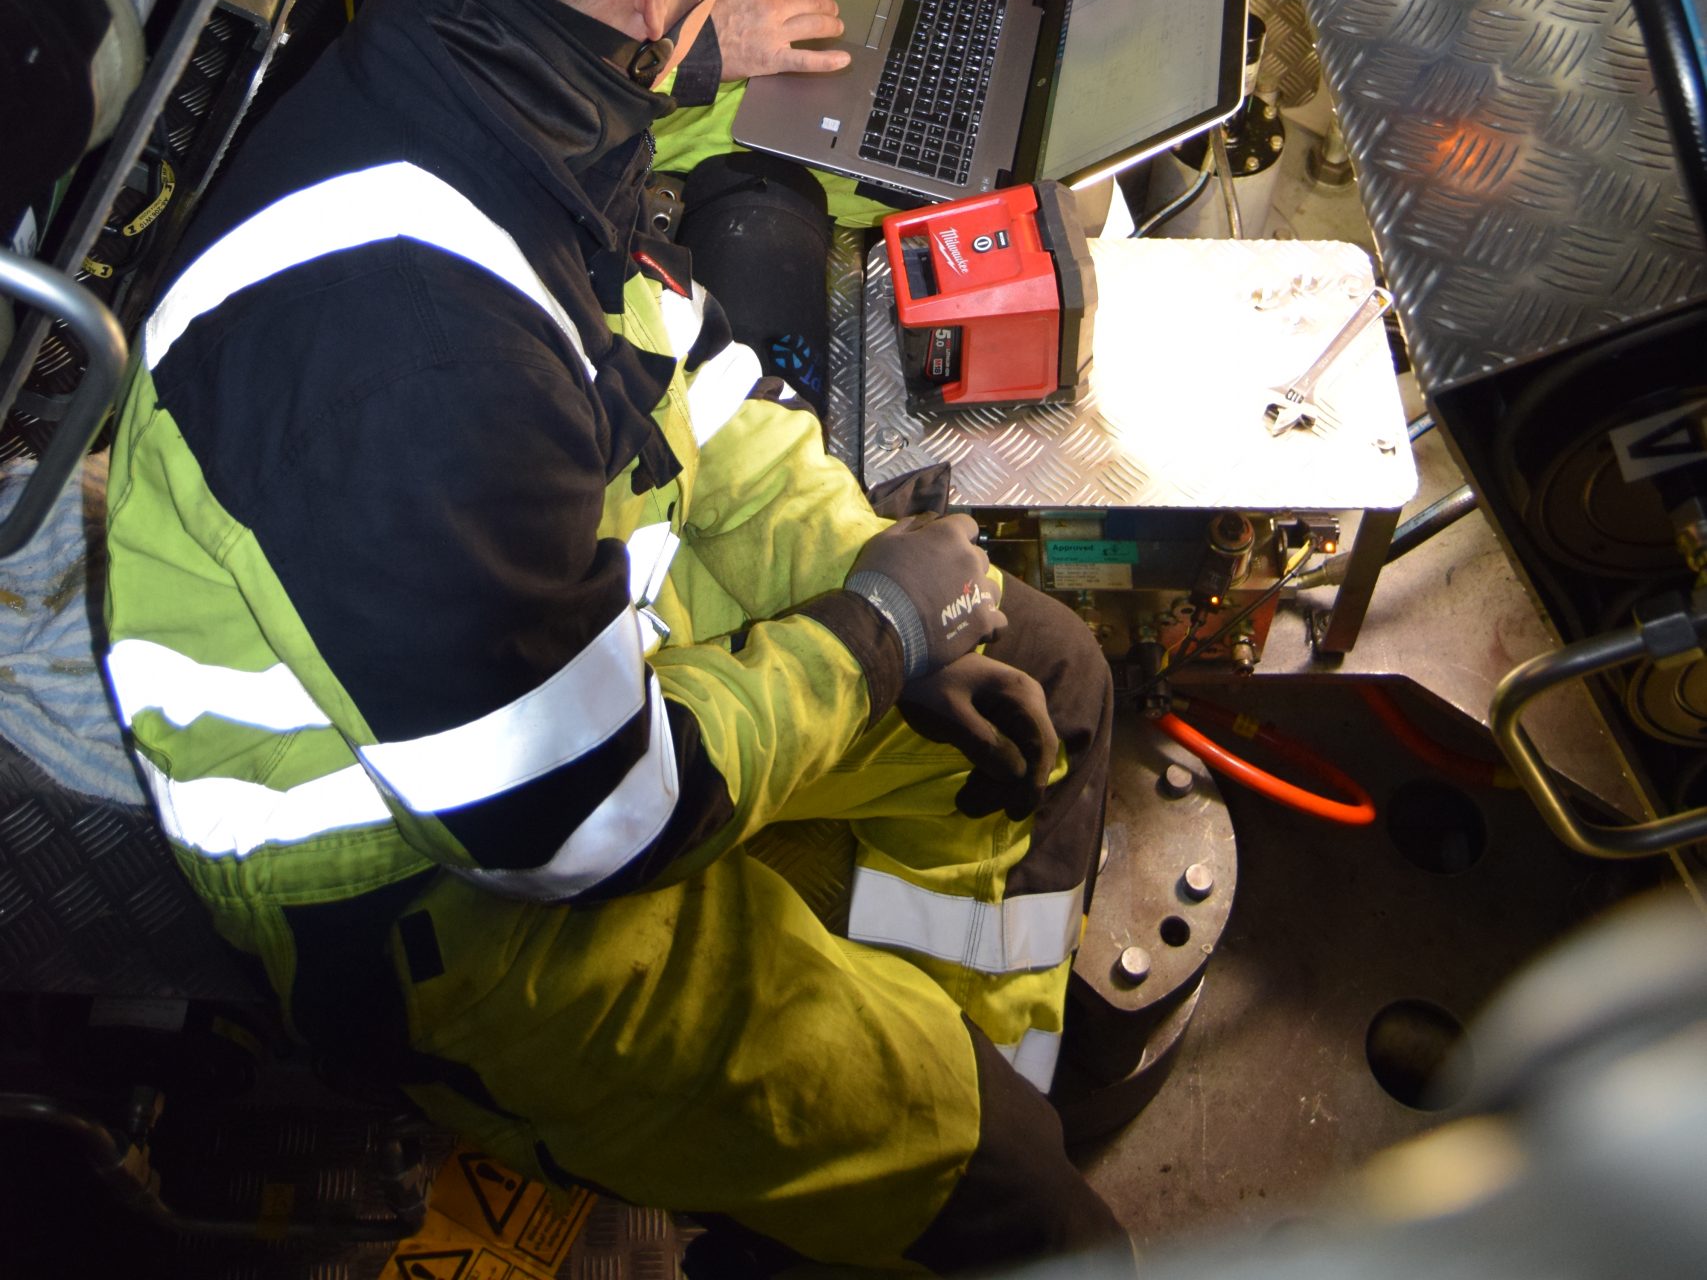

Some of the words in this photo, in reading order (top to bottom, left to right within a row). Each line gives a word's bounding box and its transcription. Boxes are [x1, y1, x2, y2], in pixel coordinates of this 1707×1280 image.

[939, 227, 969, 274] Milwaukee
[1052, 543, 1095, 552] Approved
[941, 583, 982, 627] NINJA
